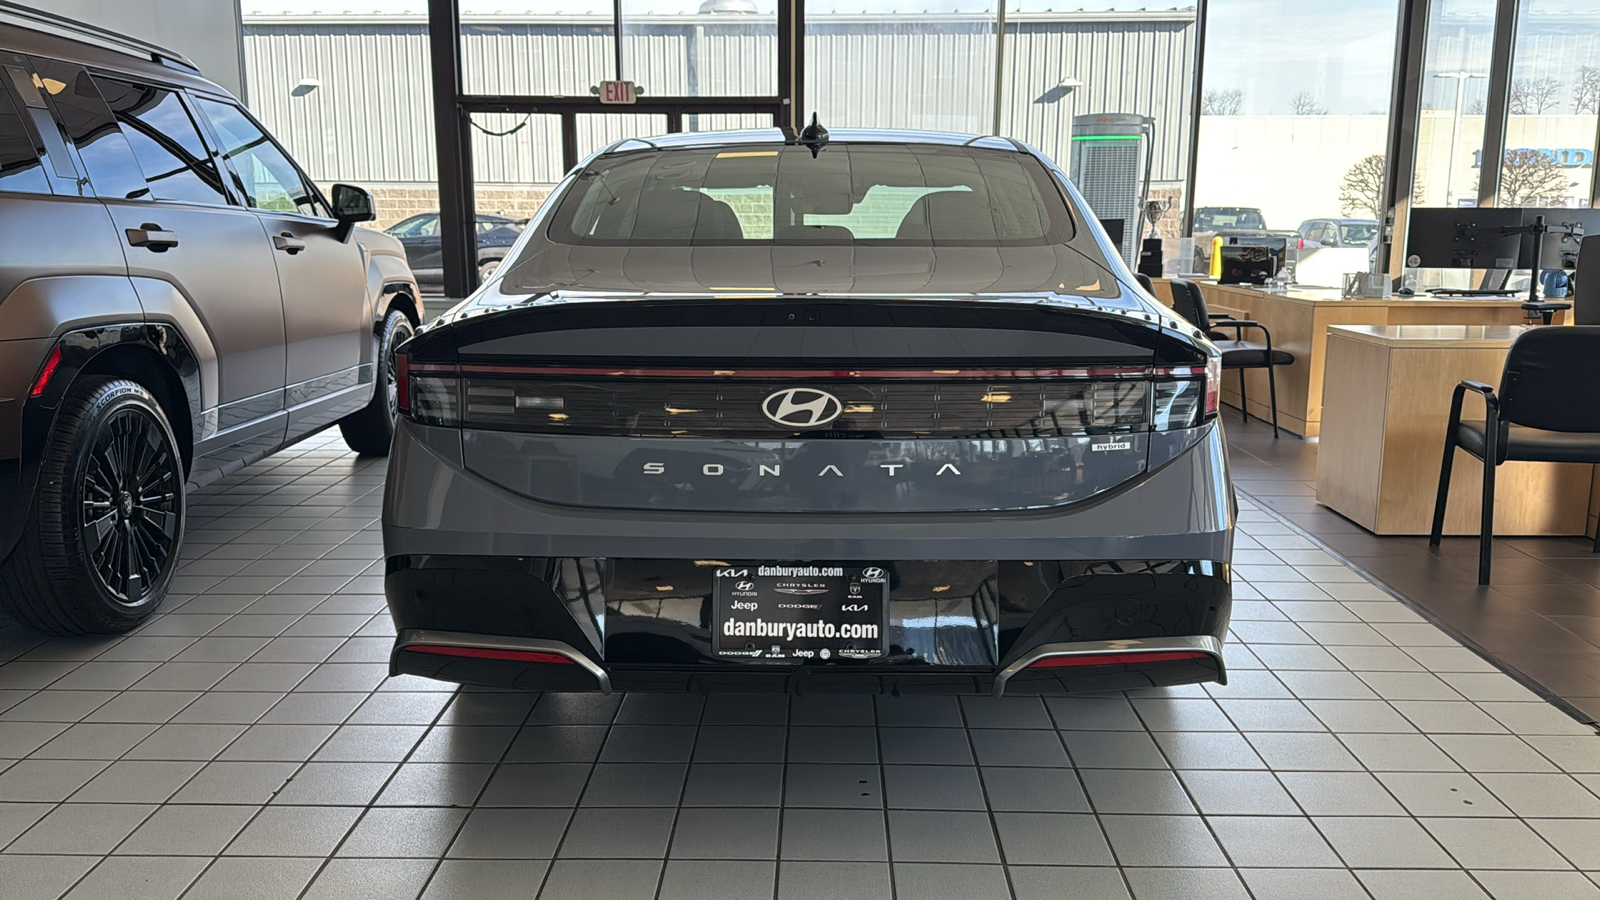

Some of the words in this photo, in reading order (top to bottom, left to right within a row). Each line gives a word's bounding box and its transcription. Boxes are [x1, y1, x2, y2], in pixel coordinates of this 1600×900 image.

[606, 82, 630, 101] EXIT
[96, 387, 132, 411] SCORPION
[643, 462, 961, 477] SONATA
[716, 568, 748, 577] KIA
[758, 565, 843, 577] danburyauto.com
[731, 600, 758, 612] Jeep
[841, 604, 868, 612] KIA
[723, 617, 878, 641] danburyauto.com
[792, 648, 814, 659] Jeep
